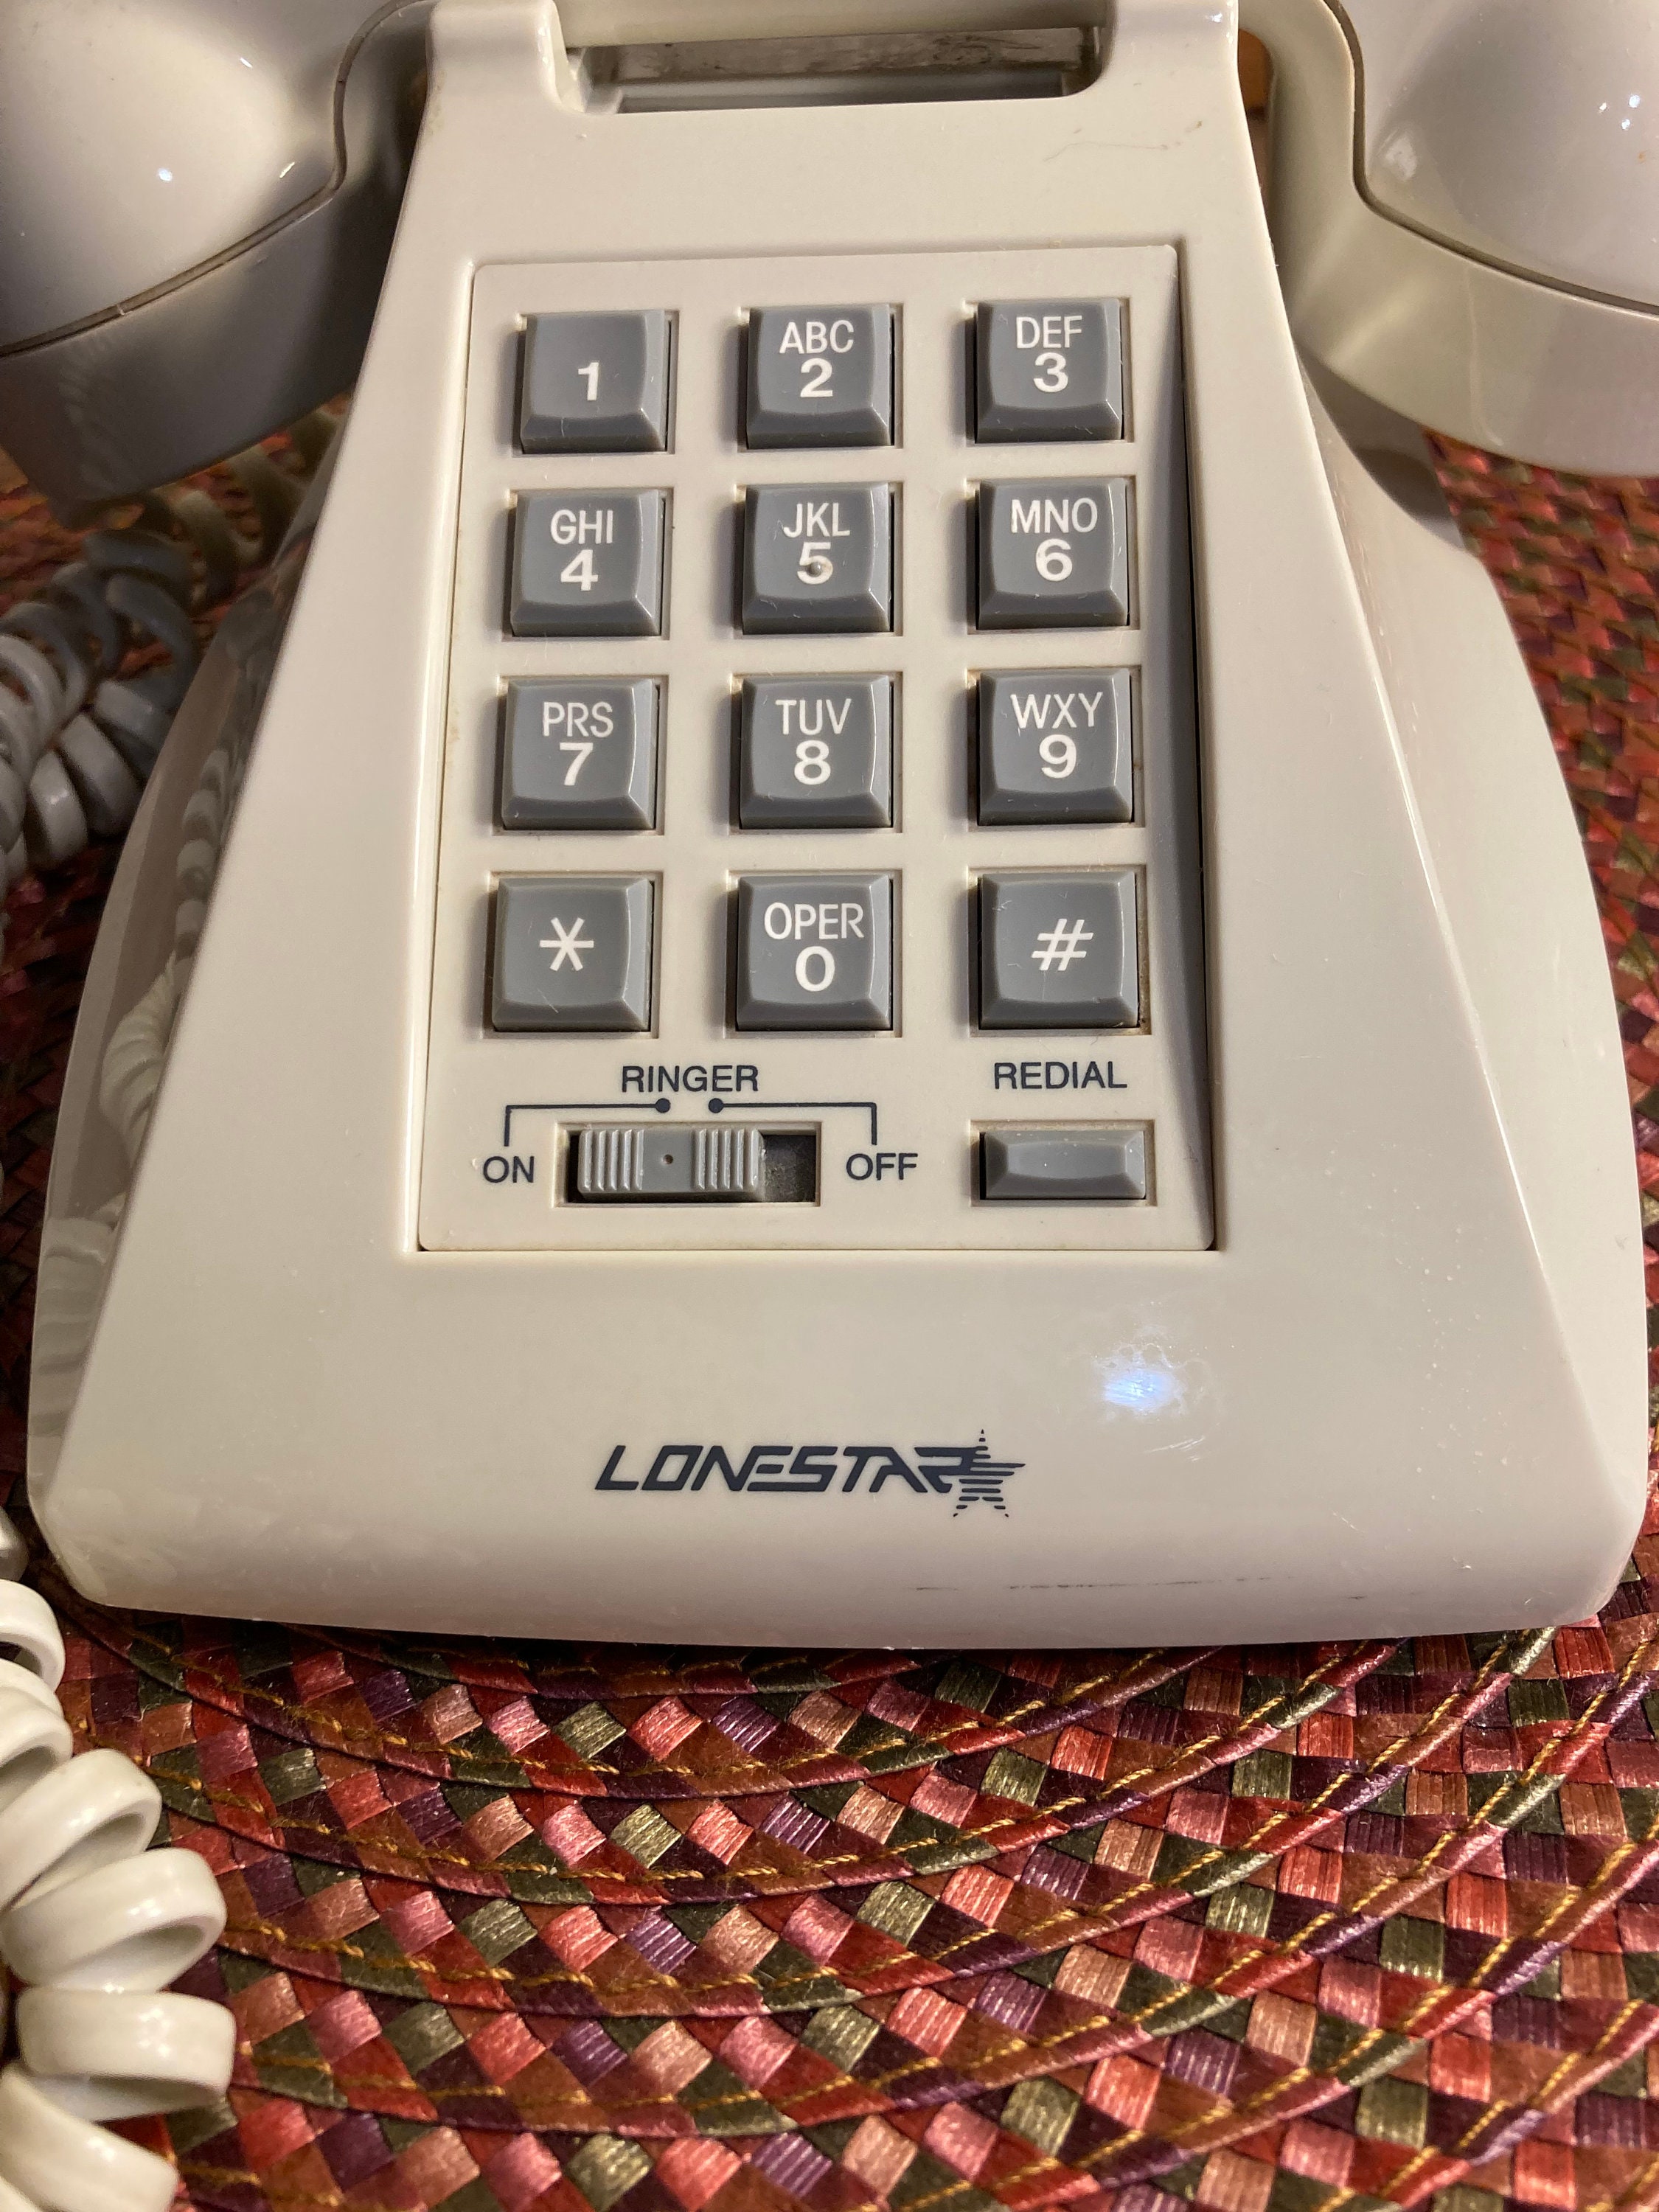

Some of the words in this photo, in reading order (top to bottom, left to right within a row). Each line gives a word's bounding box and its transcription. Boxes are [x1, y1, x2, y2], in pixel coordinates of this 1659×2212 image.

[779, 320, 853, 354] ABC
[1017, 316, 1082, 348] DEF
[578, 362, 599, 400] 1
[800, 358, 832, 397] 2
[1034, 352, 1068, 392] 3
[551, 509, 613, 544] GHI
[782, 503, 849, 538] JKL
[1012, 498, 1097, 533] MNO
[561, 549, 598, 591] 4
[797, 542, 833, 584] 5
[1036, 538, 1072, 581] 6
[543, 702, 613, 737] PRS
[776, 699, 851, 735] TUV
[1010, 692, 1102, 726] WXY
[560, 742, 593, 785] 7
[794, 740, 830, 785] 8
[1040, 734, 1077, 778] 9
[765, 902, 863, 939] OPER
[796, 946, 835, 991] 0
[622, 1065, 758, 1092] RINGER
[995, 1061, 1127, 1089] REDIAL
[483, 1156, 534, 1183] ON
[846, 1153, 918, 1180] OFF
[594, 1444, 1007, 1496] LONESTAR
